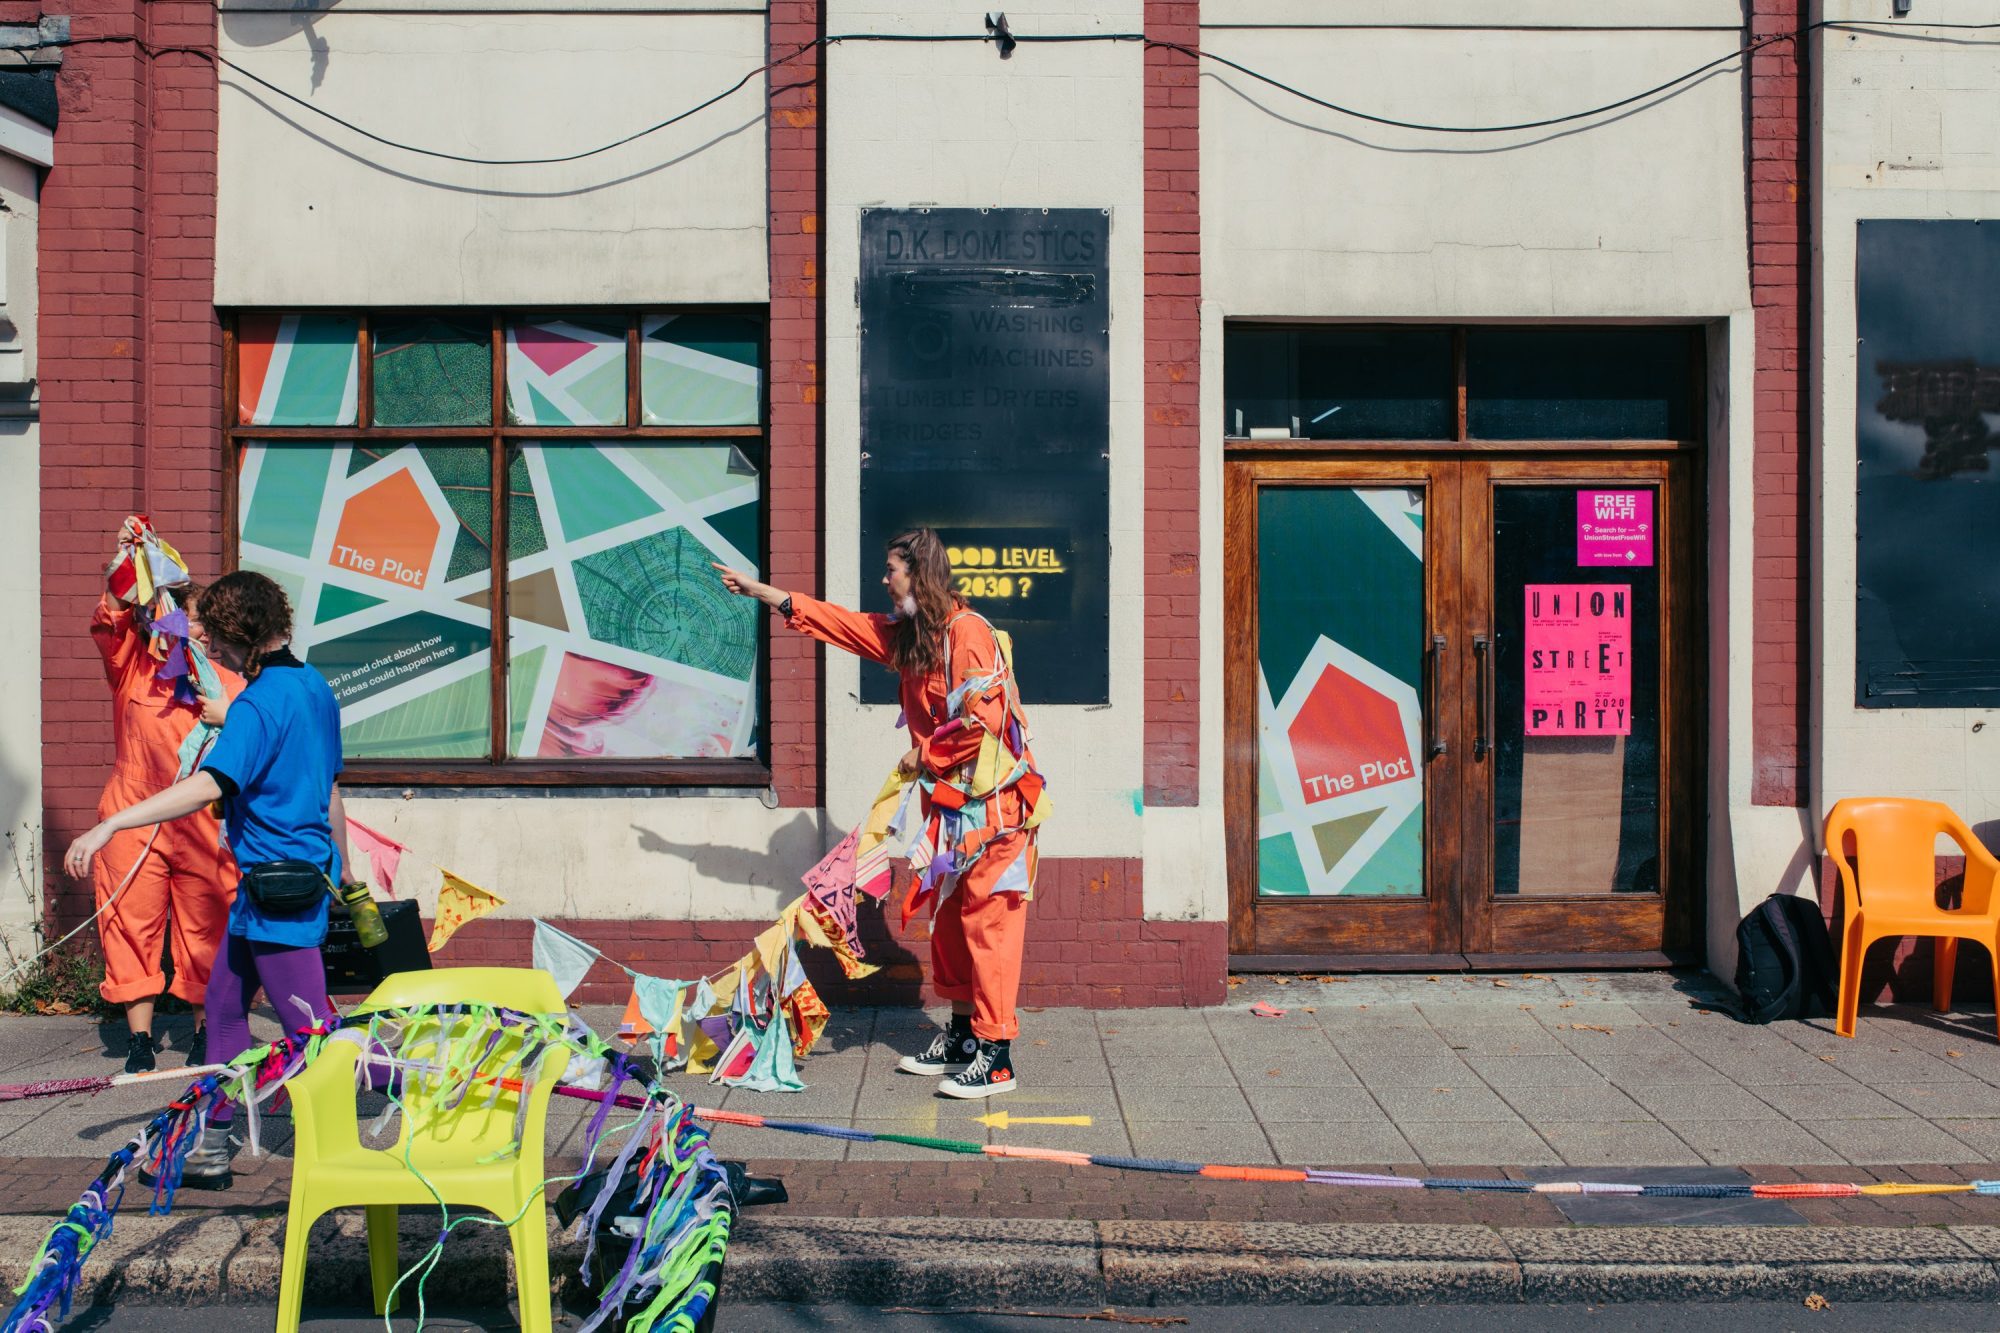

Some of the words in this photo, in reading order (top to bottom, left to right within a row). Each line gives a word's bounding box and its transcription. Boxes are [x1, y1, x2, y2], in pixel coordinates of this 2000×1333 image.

[886, 229, 938, 260] D.K.
[943, 229, 1096, 261] DOMESTICS
[970, 311, 1085, 333] WASHING
[967, 345, 1094, 368] MACHINES
[878, 386, 976, 408] TUMBLE
[983, 386, 1079, 408] DRYERS
[879, 419, 982, 441] FRIDGES
[1594, 495, 1636, 507] FREE
[1595, 507, 1635, 520] WI-FI
[336, 545, 375, 572] The
[380, 558, 423, 586] Plot
[946, 547, 996, 566] OOD
[1002, 548, 1060, 567] LEVEL
[958, 576, 1012, 597] 2030
[1533, 592, 1624, 618] UNION
[327, 677, 341, 687] op
[341, 672, 352, 682] in
[352, 663, 371, 678] and
[371, 655, 394, 670] chat
[393, 643, 422, 661] about
[421, 635, 442, 649] how
[1532, 644, 1624, 674] STREET
[341, 681, 369, 697] ideas
[369, 668, 396, 686] could
[396, 655, 433, 675] happen
[432, 645, 455, 660] here
[1595, 698, 1625, 708] 2020
[1532, 701, 1624, 729] PARTY
[1305, 774, 1354, 798] The
[1359, 756, 1410, 785] Plot
